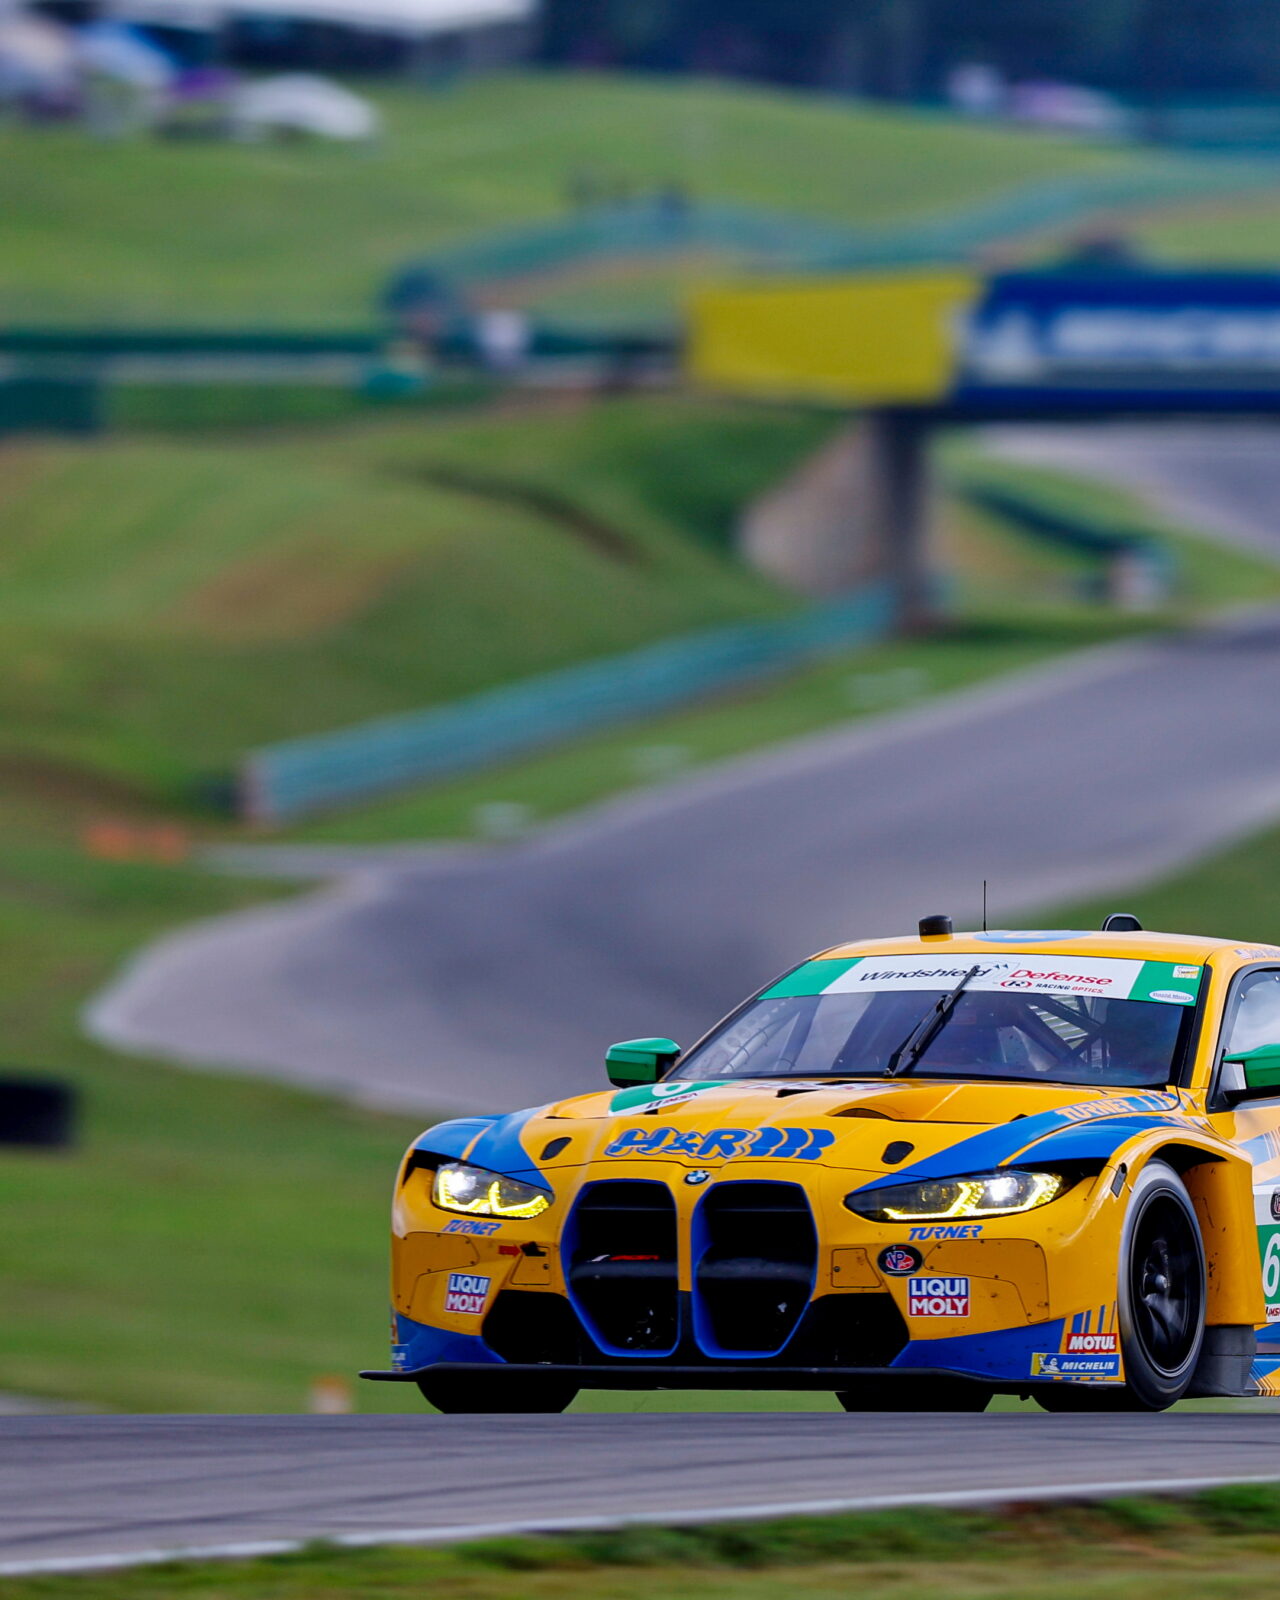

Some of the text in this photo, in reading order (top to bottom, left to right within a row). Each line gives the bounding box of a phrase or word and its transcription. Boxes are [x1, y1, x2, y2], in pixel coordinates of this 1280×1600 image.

[859, 968, 1113, 985] Windshied Defense
[1071, 986, 1104, 994] OPTICS
[1054, 1097, 1138, 1121] TURNER
[603, 1127, 752, 1159] H&R
[442, 1219, 502, 1236] TURNER
[908, 1225, 983, 1241] TURNER
[450, 1274, 489, 1295] LIQUI
[911, 1279, 967, 1297] LIQUI
[446, 1294, 485, 1312] MOLY
[911, 1298, 968, 1315] MOLY
[1068, 1335, 1116, 1350] MOTUL
[1061, 1361, 1115, 1370] MICHELIN
